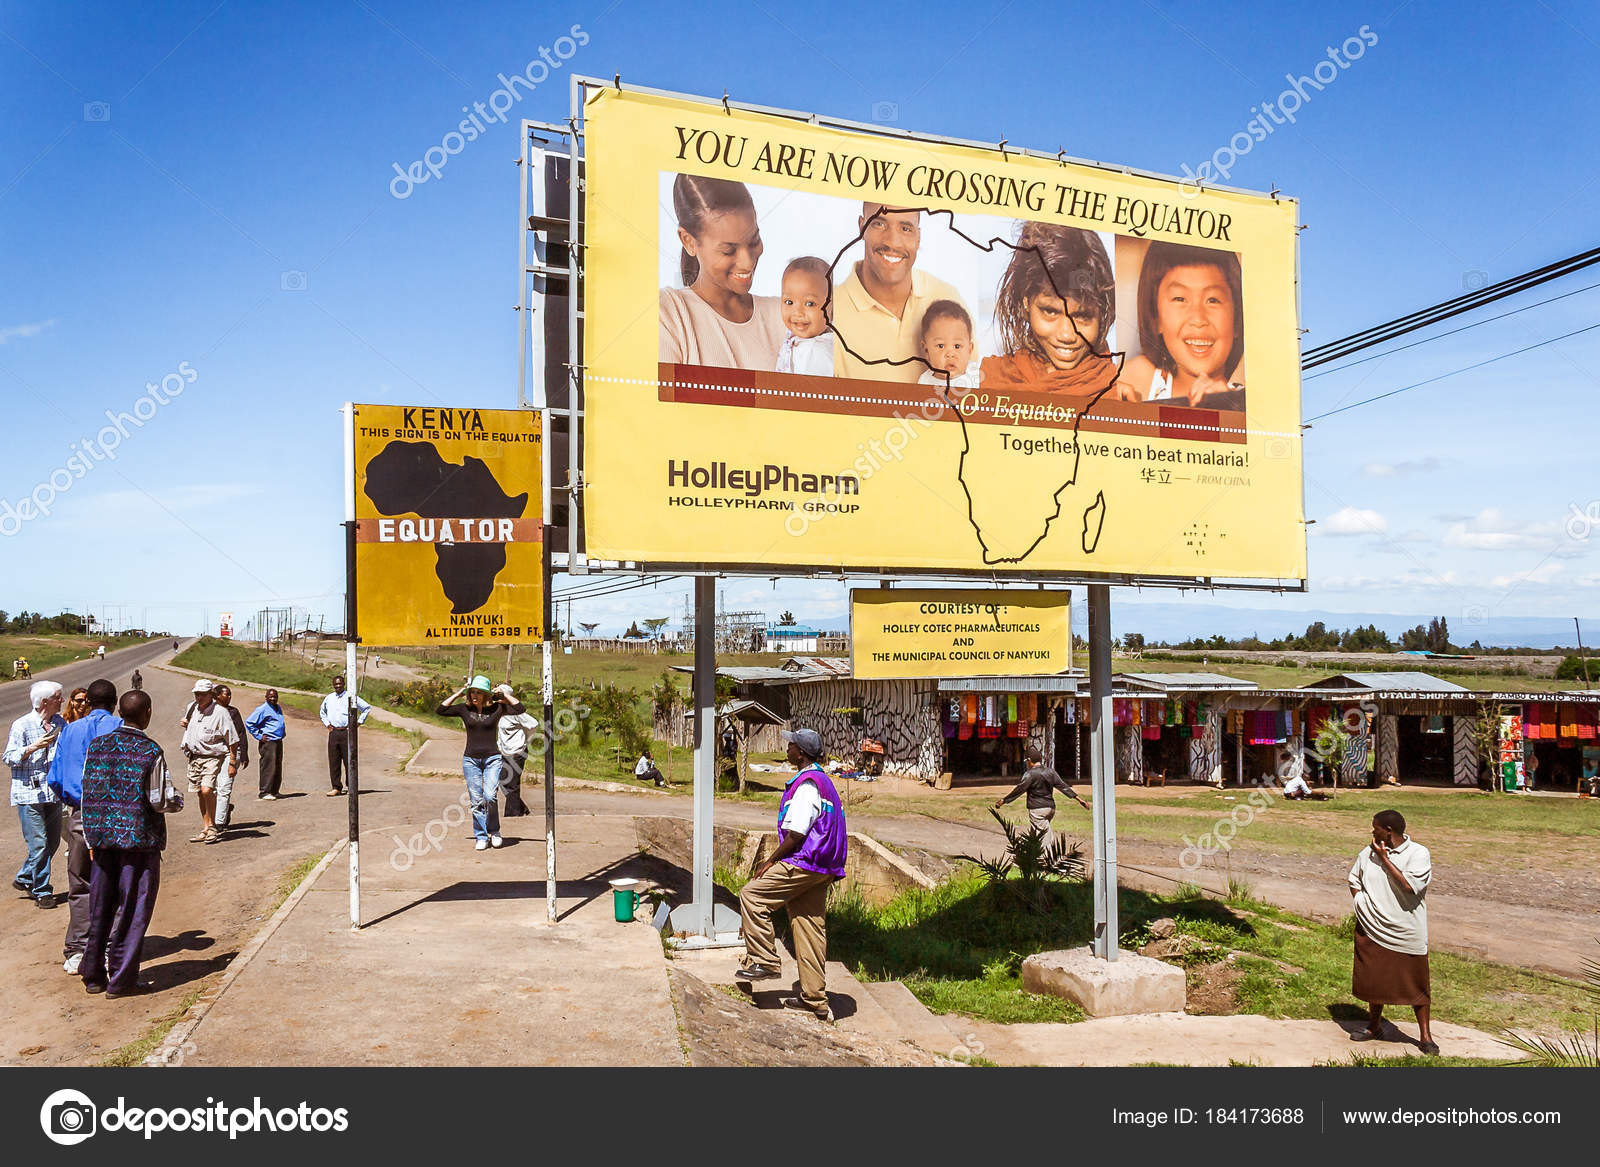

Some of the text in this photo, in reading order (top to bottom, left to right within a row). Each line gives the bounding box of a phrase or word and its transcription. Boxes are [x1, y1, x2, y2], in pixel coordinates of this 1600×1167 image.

[675, 126, 1233, 242] YOU ARE NOW CROSSING THE EQUATOR
[992, 395, 1075, 425] Equator
[403, 408, 484, 431] KENYA
[360, 428, 541, 443] THIS SIGN IS ON THE EQUATOR
[1000, 433, 1249, 468] Together we can beat malaria!
[668, 459, 859, 497] HolleyPharm
[1140, 468, 1172, 484] 华立
[1196, 475, 1251, 487] FROM CHINA
[669, 496, 860, 514] HOLLEYPHARM GROUP
[378, 518, 514, 542] EQUATOR
[920, 603, 981, 615] COURTESY
[985, 603, 1001, 615] OF
[451, 614, 503, 625] NANYUKI
[425, 628, 484, 638] ALTITUDE
[490, 627, 521, 637] 6389
[883, 623, 1040, 633] HOLLEY COTEC PHARMACEUTICALS
[952, 638, 974, 646] AND
[872, 650, 1050, 662] THE MUNICIPAL COUNCIL OF NANYUKI
